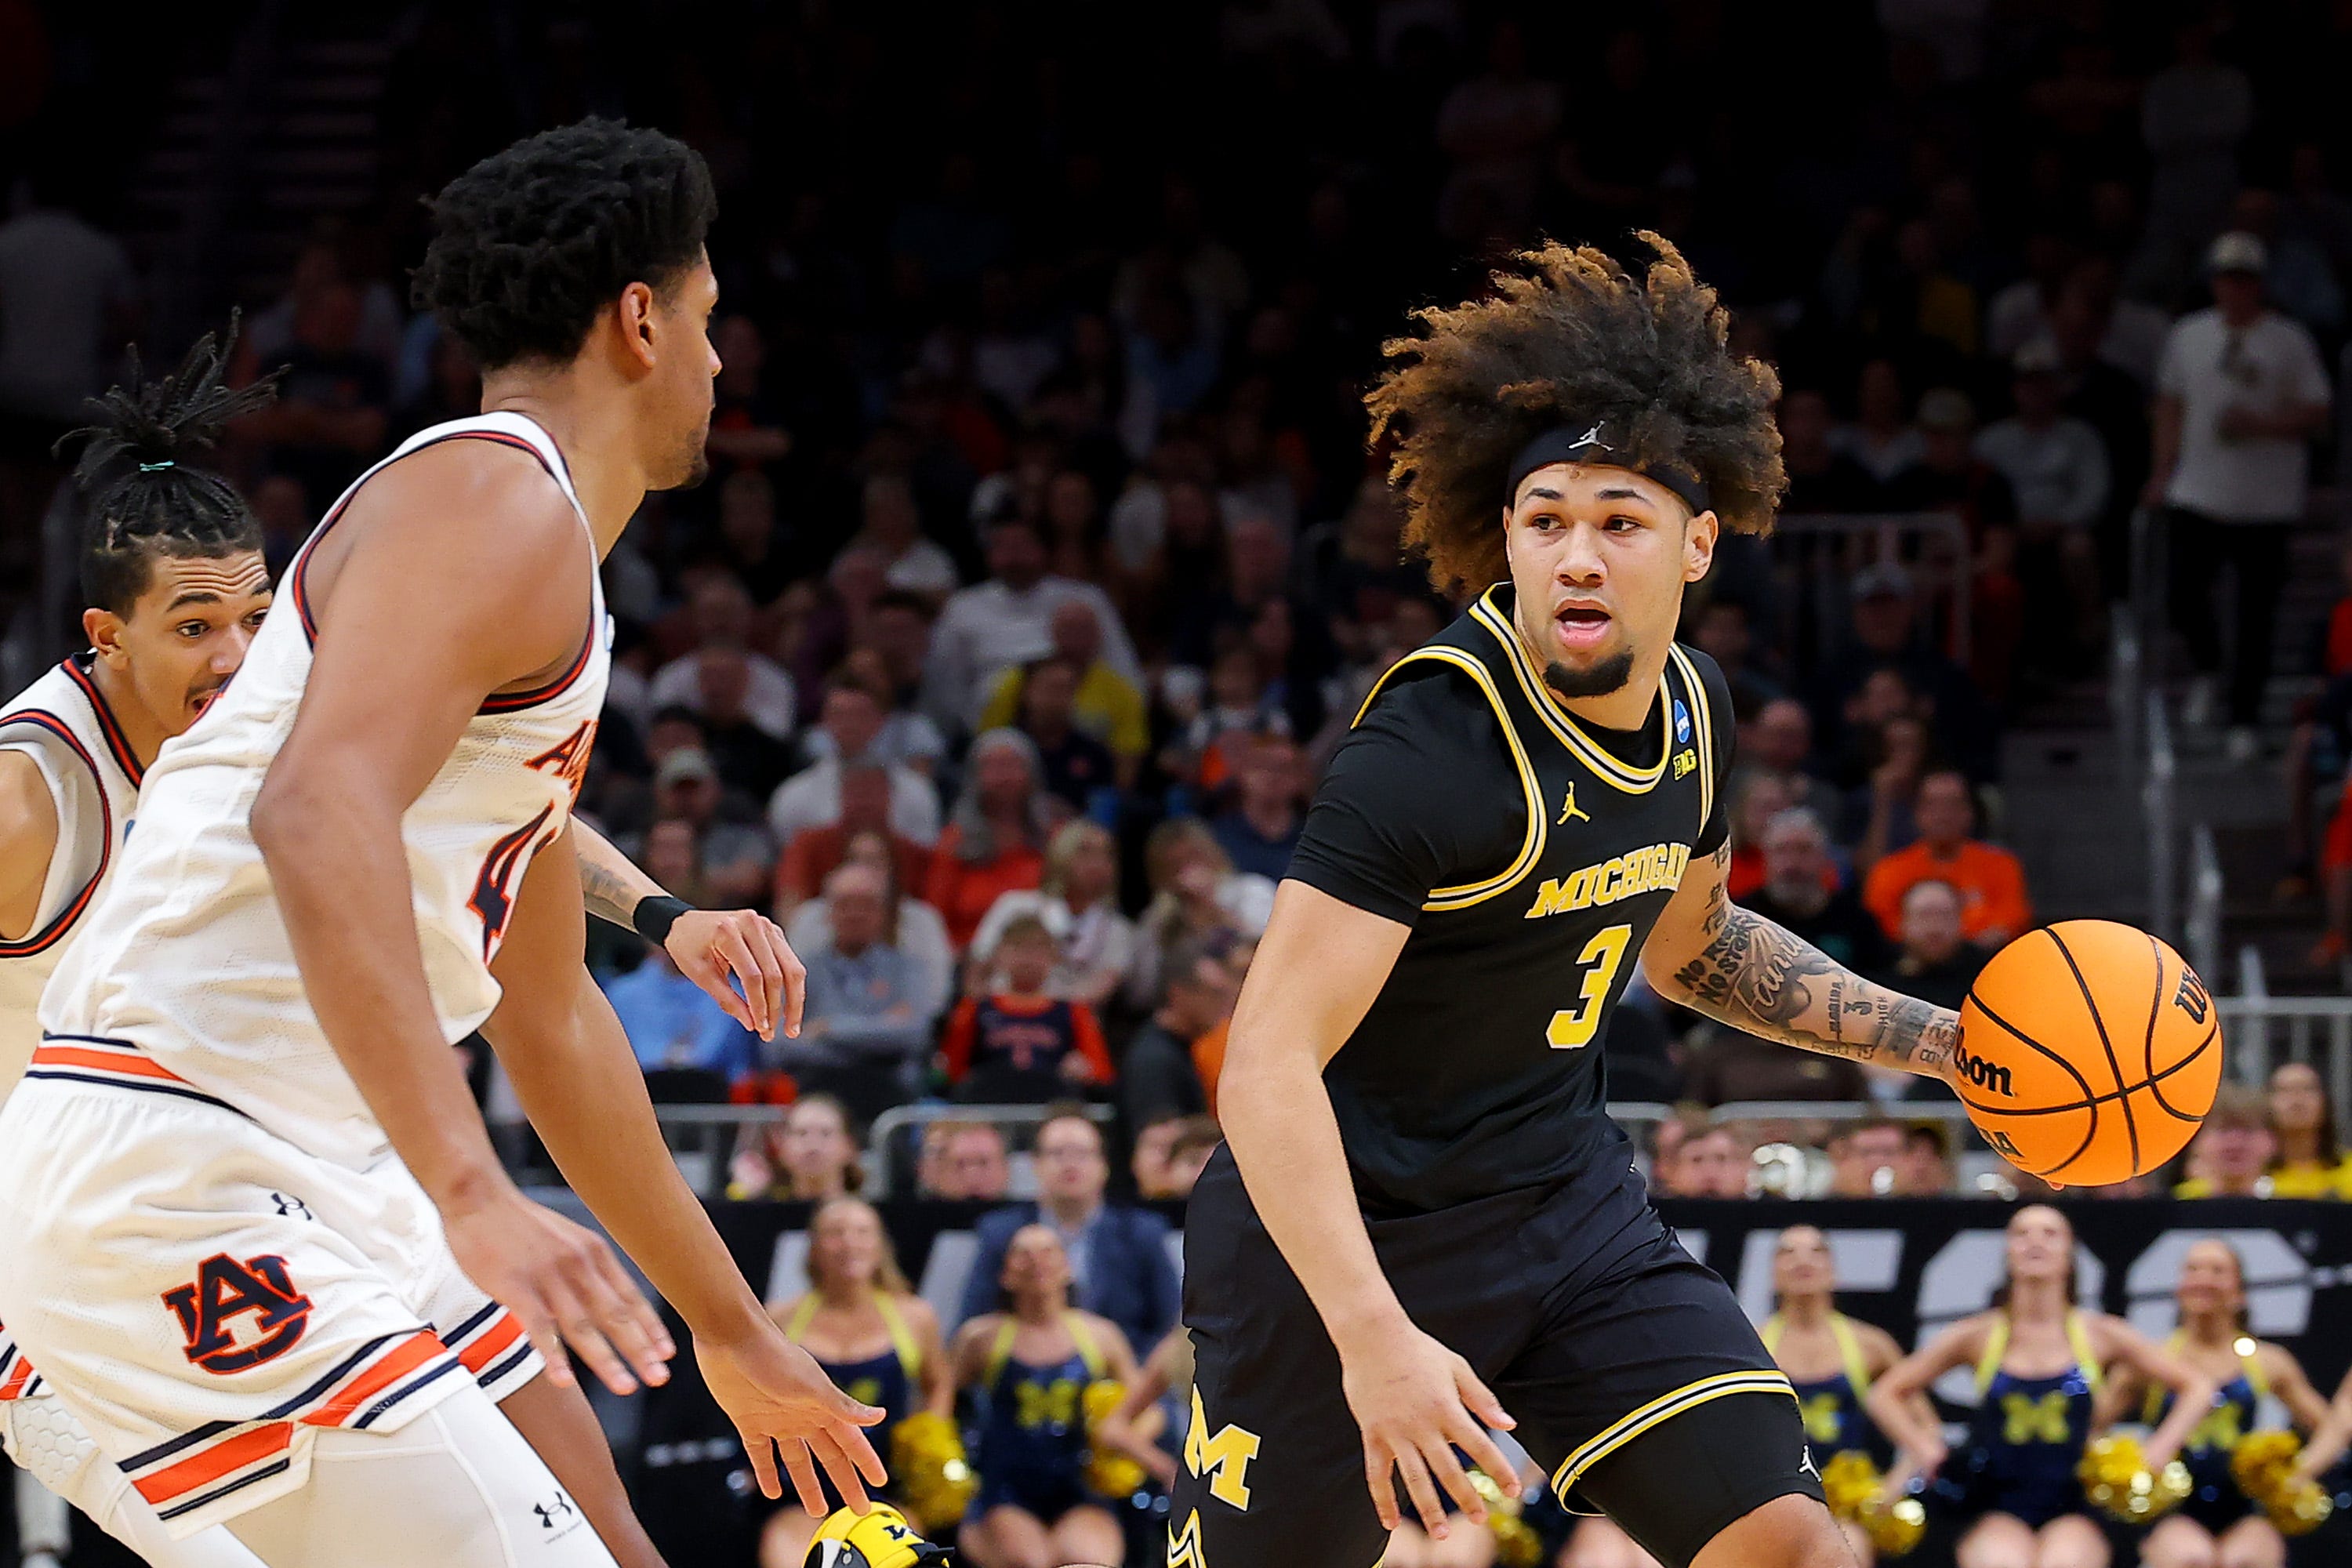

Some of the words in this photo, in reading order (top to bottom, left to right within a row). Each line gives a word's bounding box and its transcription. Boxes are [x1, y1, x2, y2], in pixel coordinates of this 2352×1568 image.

[1545, 924, 1632, 1049] 3
[1955, 1025, 2014, 1098] lson
[1184, 1382, 1261, 1512] M
